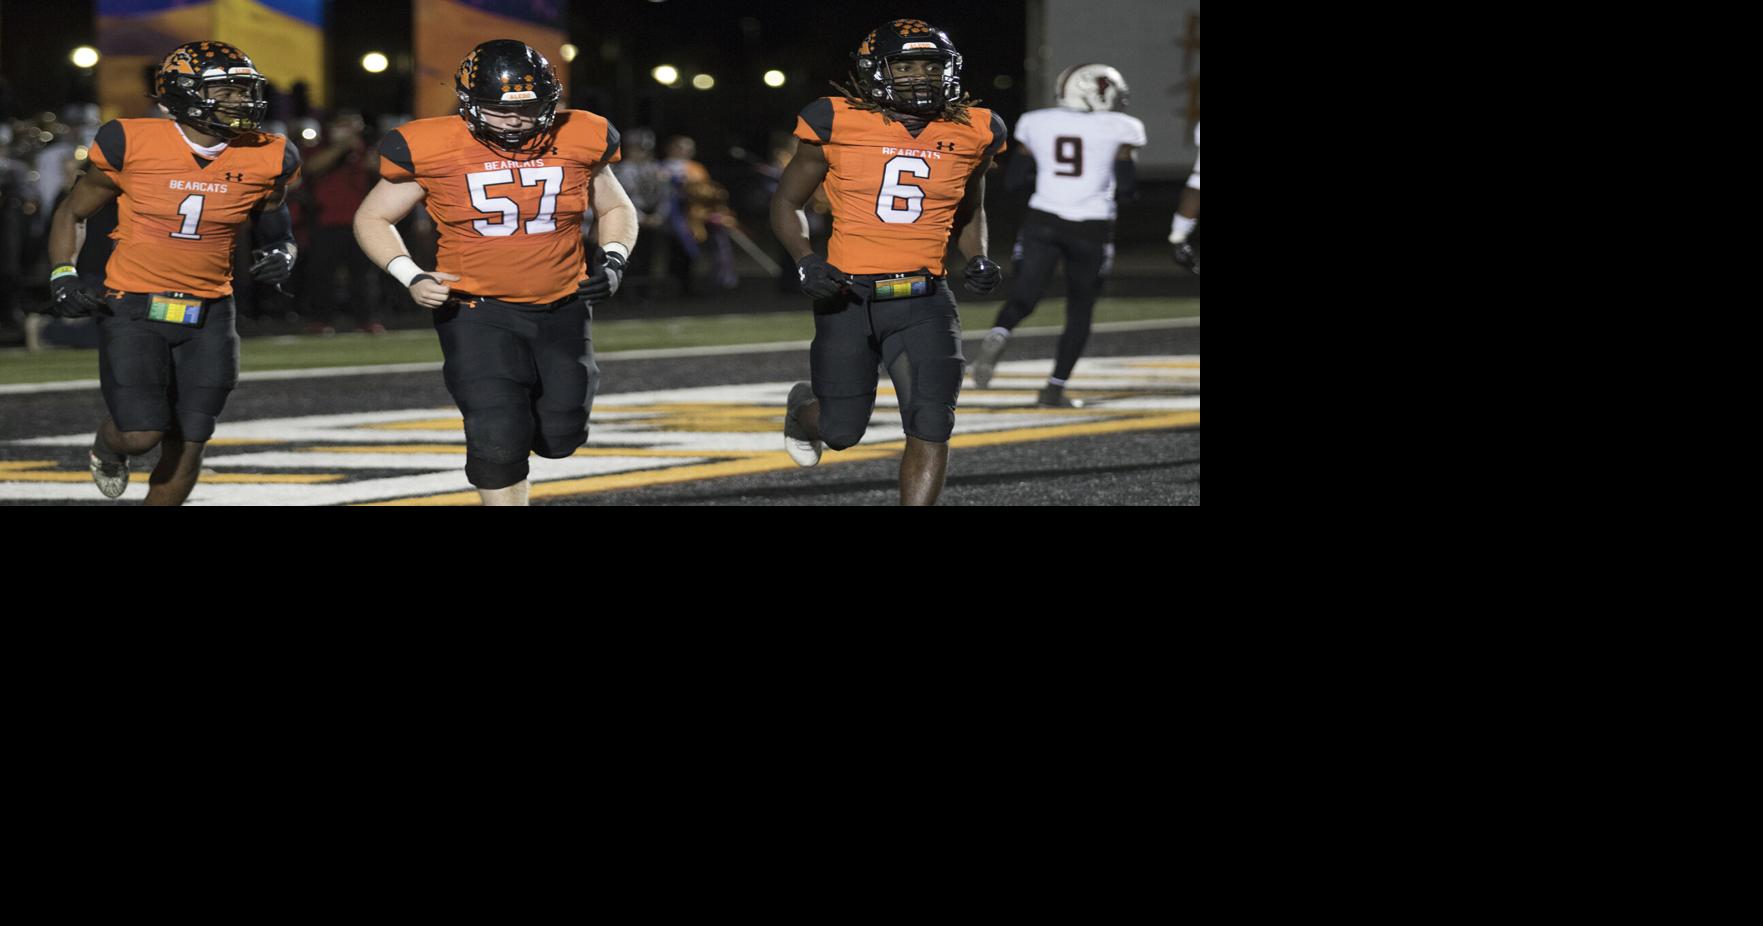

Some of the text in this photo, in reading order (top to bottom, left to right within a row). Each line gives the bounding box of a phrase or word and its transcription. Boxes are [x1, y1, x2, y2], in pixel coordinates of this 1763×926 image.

[1055, 136, 1084, 177] 9
[169, 179, 228, 194] BEARCATS
[465, 167, 564, 237] 57
[875, 155, 931, 224] 6
[169, 193, 205, 240] 1
